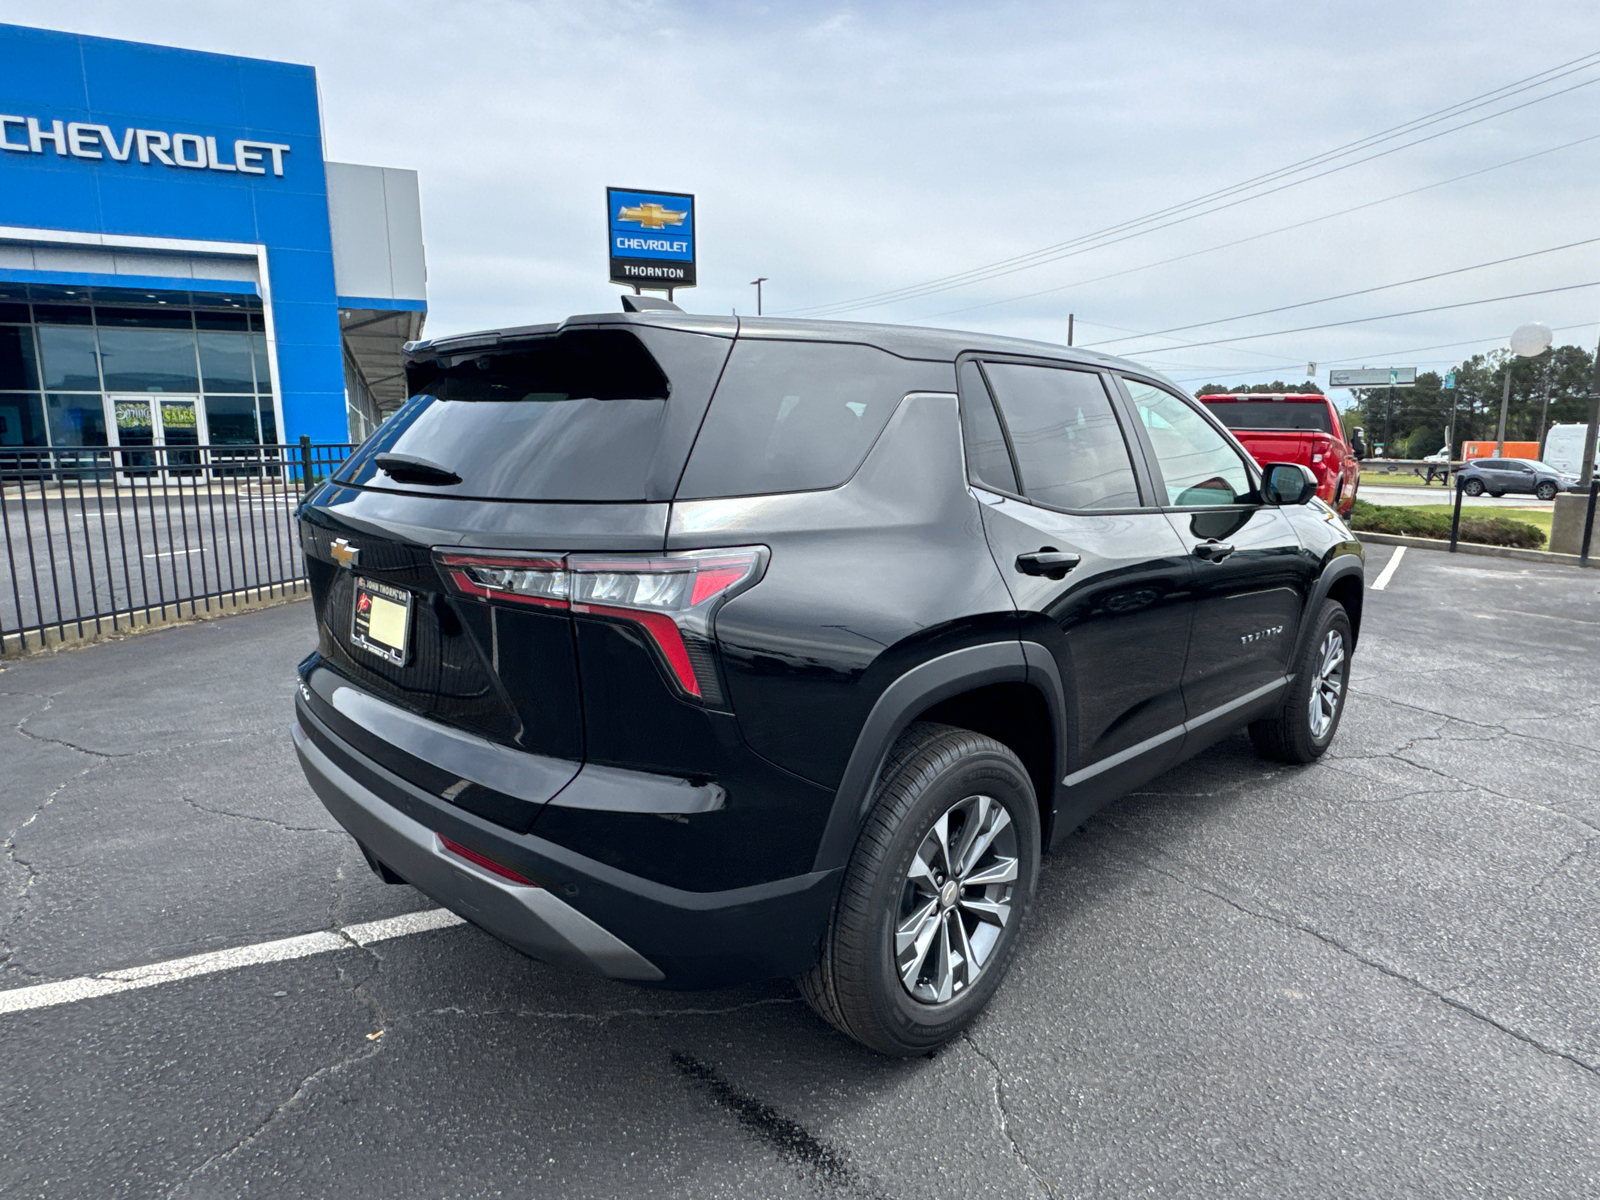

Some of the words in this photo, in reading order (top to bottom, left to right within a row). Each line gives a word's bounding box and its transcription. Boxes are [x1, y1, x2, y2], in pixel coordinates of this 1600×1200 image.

[0, 114, 290, 176] CHEVROLET
[616, 237, 688, 252] CHEVROLET
[624, 265, 684, 278] THORNTON
